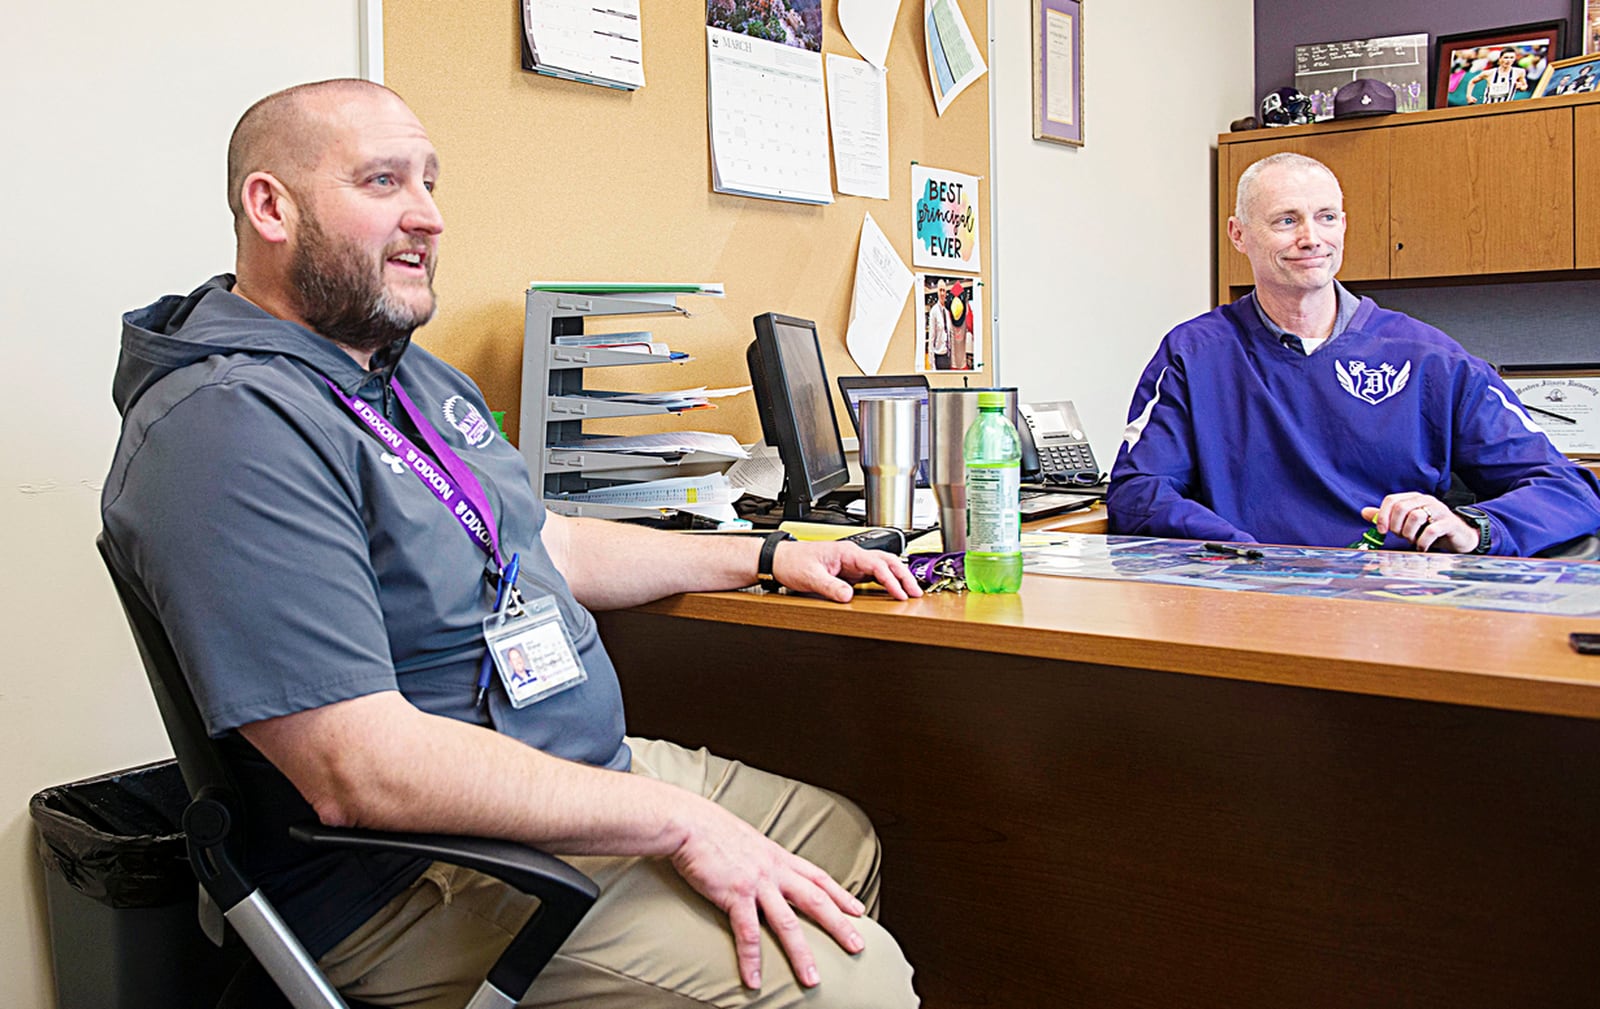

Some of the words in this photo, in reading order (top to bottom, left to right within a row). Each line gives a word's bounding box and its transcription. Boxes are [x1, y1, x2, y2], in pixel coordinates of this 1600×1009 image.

[722, 36, 752, 53] MARCH
[929, 179, 963, 204] BEST
[917, 203, 975, 235] principal
[930, 235, 962, 259] EVER
[360, 406, 403, 448] DIXON
[412, 457, 454, 500] DIXON
